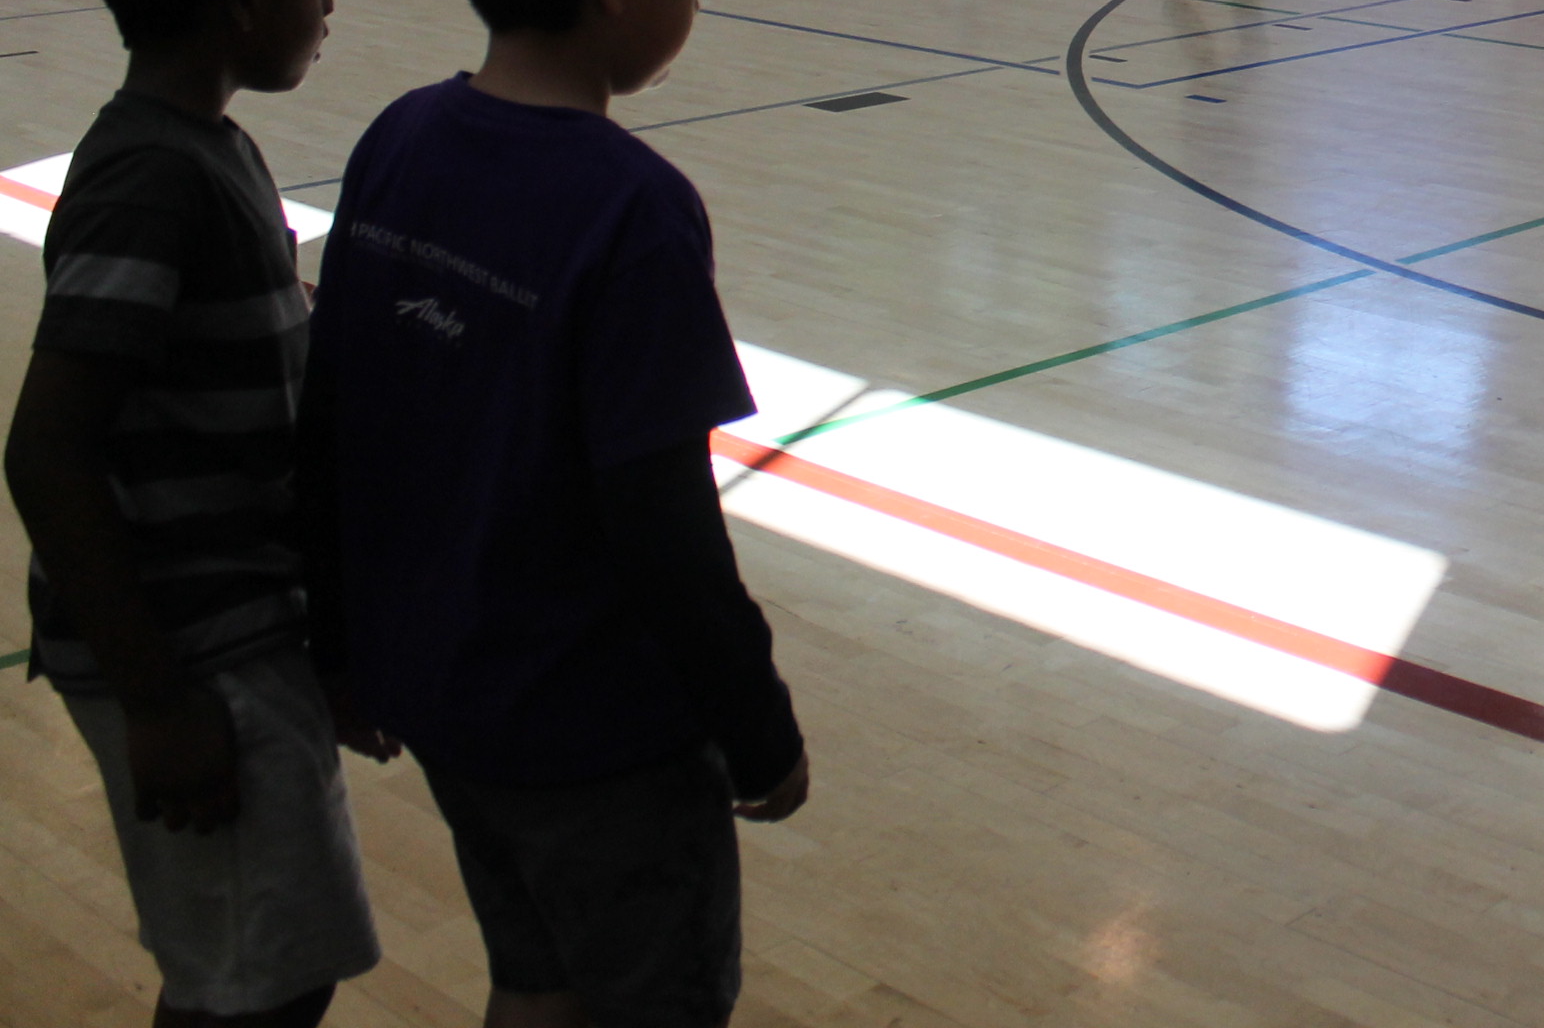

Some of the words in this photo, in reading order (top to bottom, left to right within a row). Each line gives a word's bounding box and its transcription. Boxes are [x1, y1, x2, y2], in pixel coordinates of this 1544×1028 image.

[358, 222, 407, 253] PACIFIC
[410, 238, 490, 287] NORTHWEST
[490, 275, 539, 310] BALLET
[394, 297, 465, 338] Alaska
